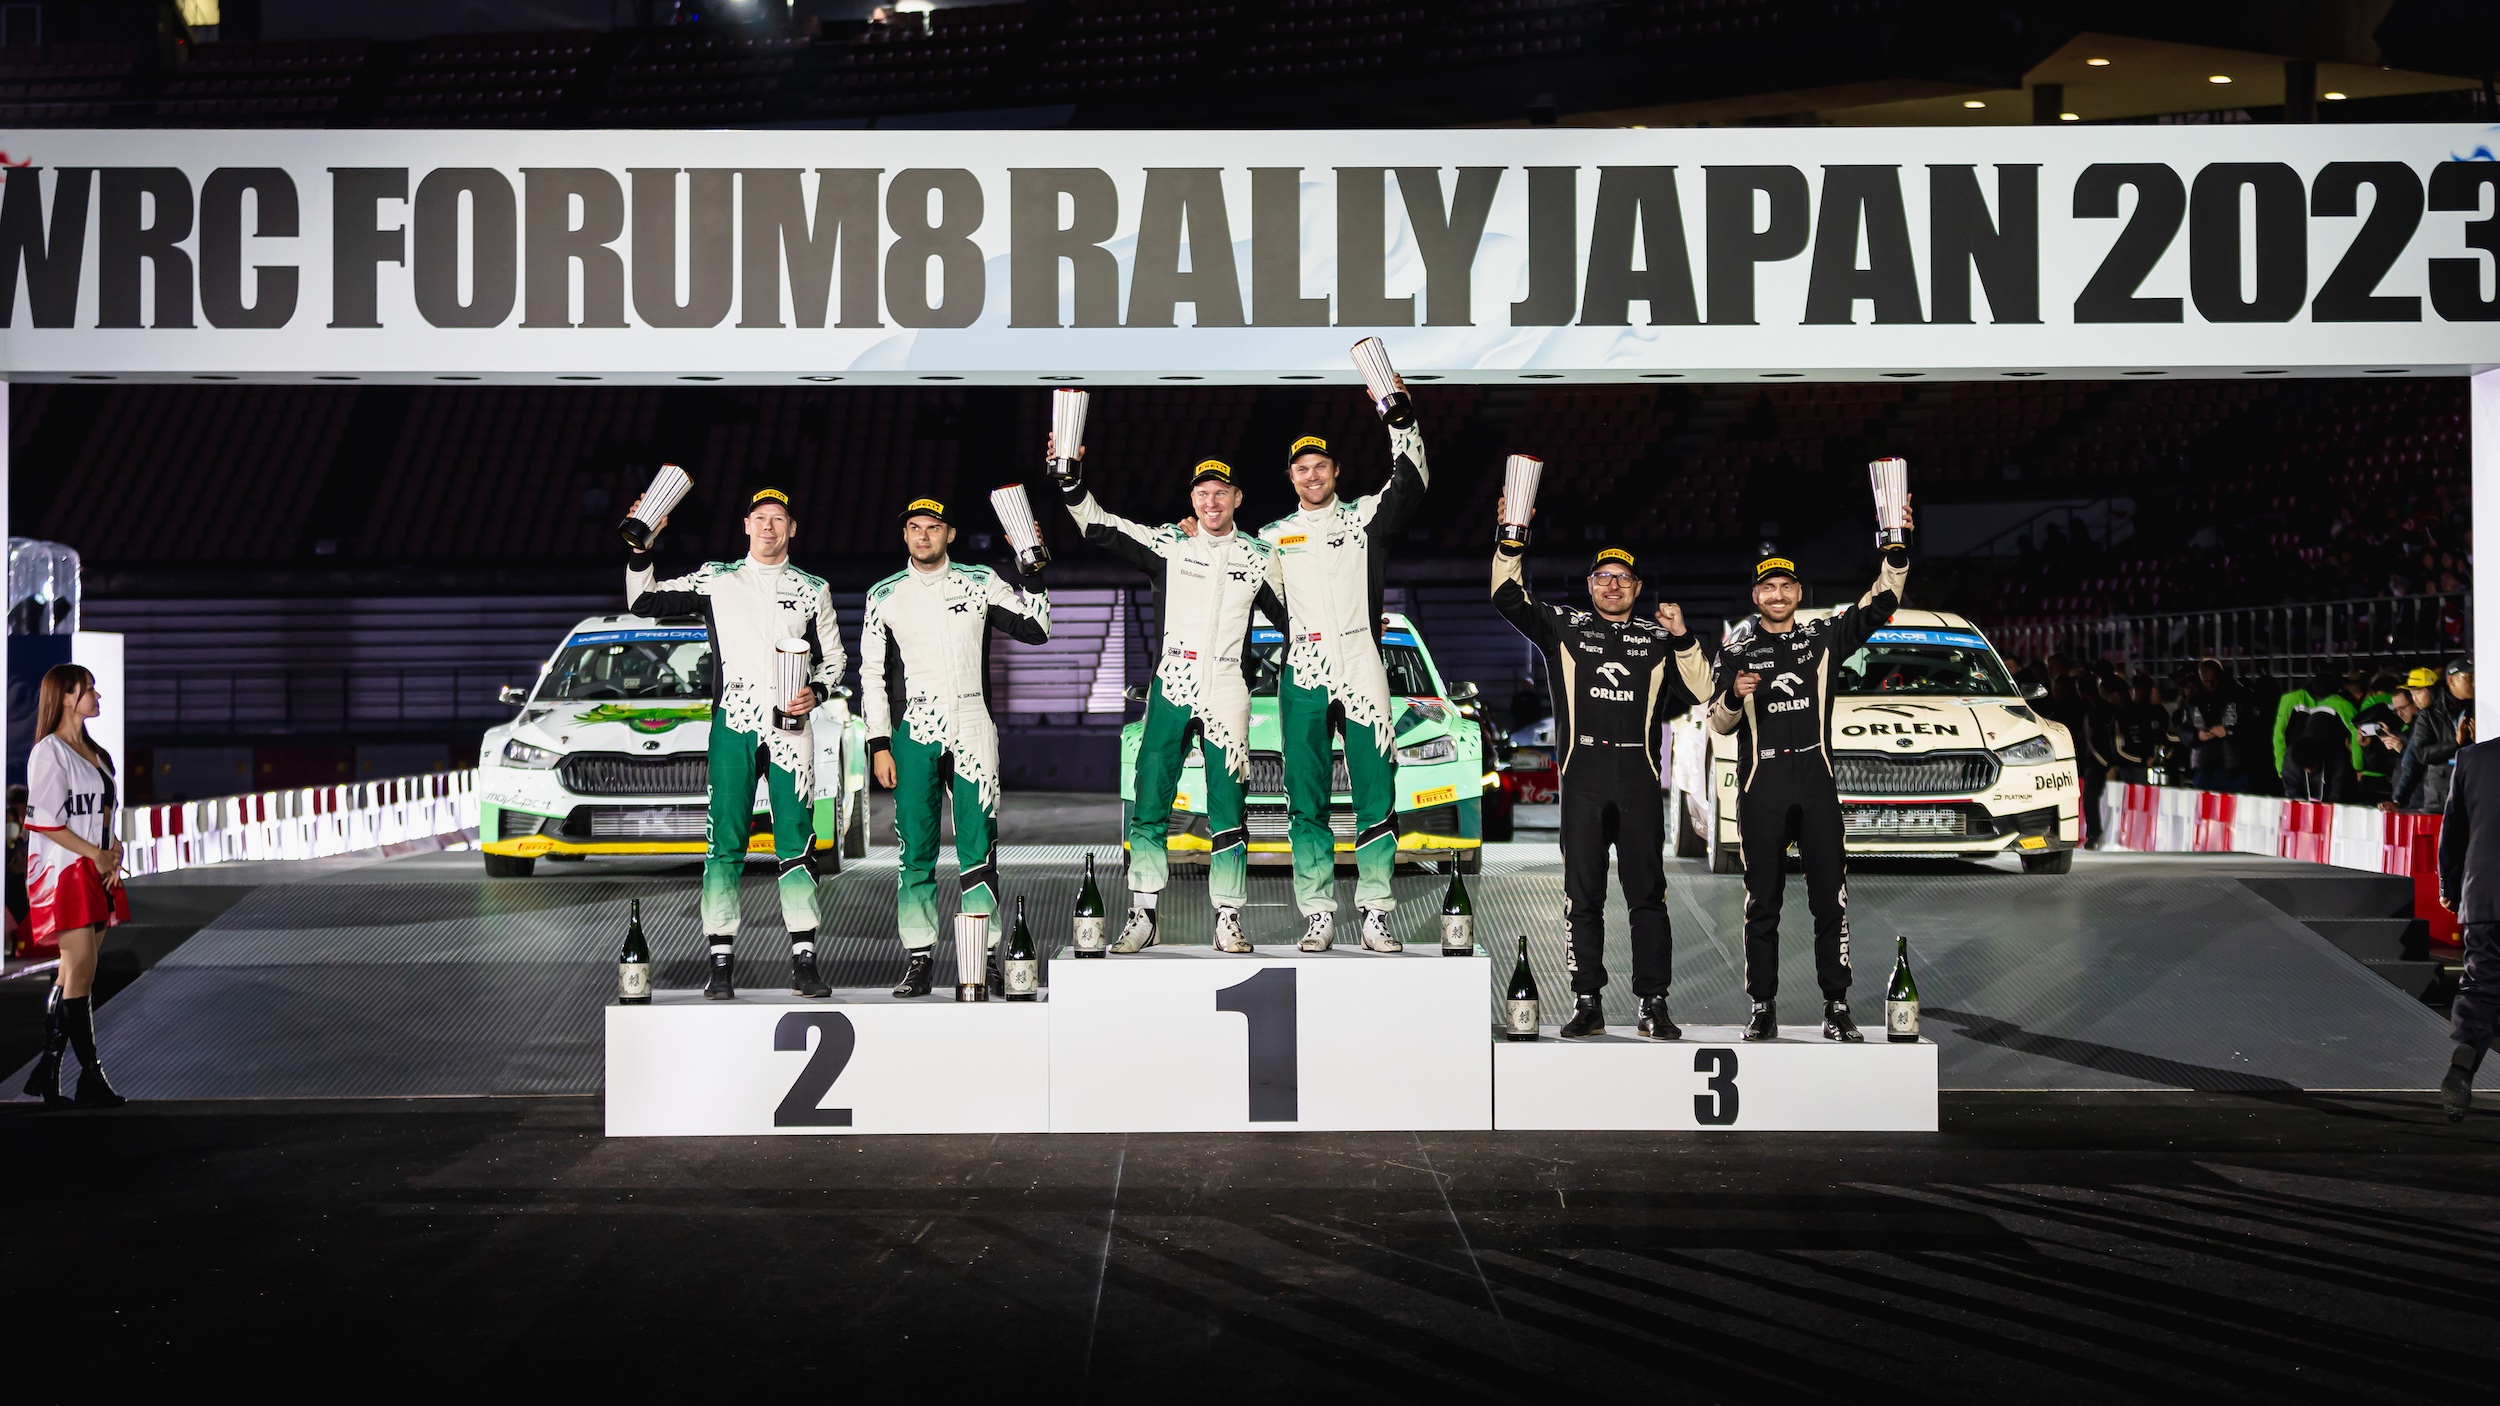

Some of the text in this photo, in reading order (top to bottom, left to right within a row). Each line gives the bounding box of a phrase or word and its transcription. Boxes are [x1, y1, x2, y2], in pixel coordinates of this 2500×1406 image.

[0, 161, 2500, 329] WRC FORUM8 RALLY JAPAN 2023
[1280, 536, 1305, 545] PIRELLI
[1622, 634, 1652, 645] Delphi
[1626, 648, 1649, 657] sjs.pl
[1589, 686, 1635, 702] ORLEN
[1767, 696, 1810, 714] ORLEN
[1841, 722, 1960, 737] ORLEN
[1760, 750, 1776, 758] OMP
[2035, 770, 2074, 791] Delphi
[1416, 788, 1453, 805] PIRELLI
[1840, 914, 1850, 967] ORLEN
[1215, 967, 1298, 1122] 1
[773, 1010, 856, 1128] 2
[1693, 1048, 1740, 1126] 3
